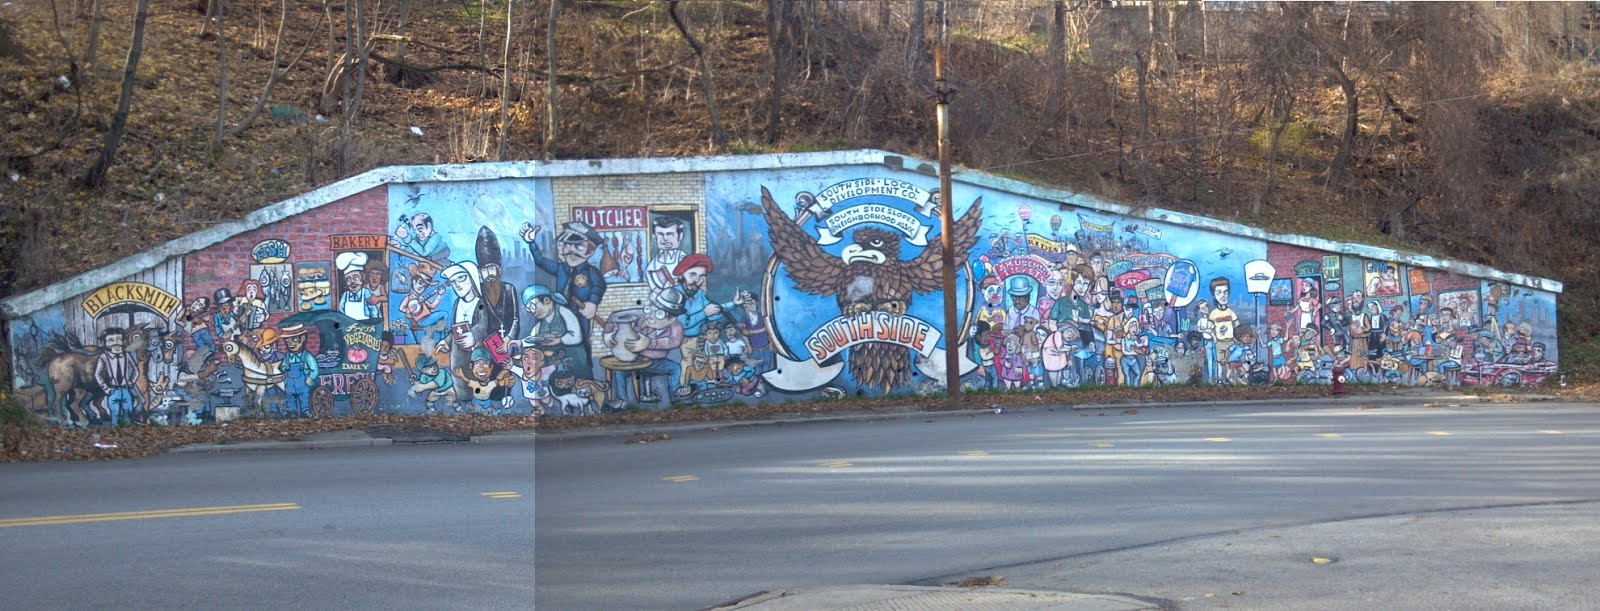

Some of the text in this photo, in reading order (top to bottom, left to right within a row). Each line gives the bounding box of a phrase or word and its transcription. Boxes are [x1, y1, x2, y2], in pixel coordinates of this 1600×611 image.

[820, 179, 920, 201] SOUTH SIDE LOCAL
[830, 186, 918, 205] DEVELOPMENT CO.
[574, 208, 643, 228] BUTCHER
[829, 208, 860, 225] SOUTH
[887, 208, 917, 225] SLOPES
[835, 213, 896, 231] NEIGHBORHOOD
[253, 240, 287, 261] FISH
[333, 235, 381, 249] BAKERY
[1028, 239, 1058, 253] RIDES
[1299, 267, 1315, 275] DELI
[88, 284, 178, 314] BLACKSMITH
[808, 312, 930, 360] SOUTH SIDE
